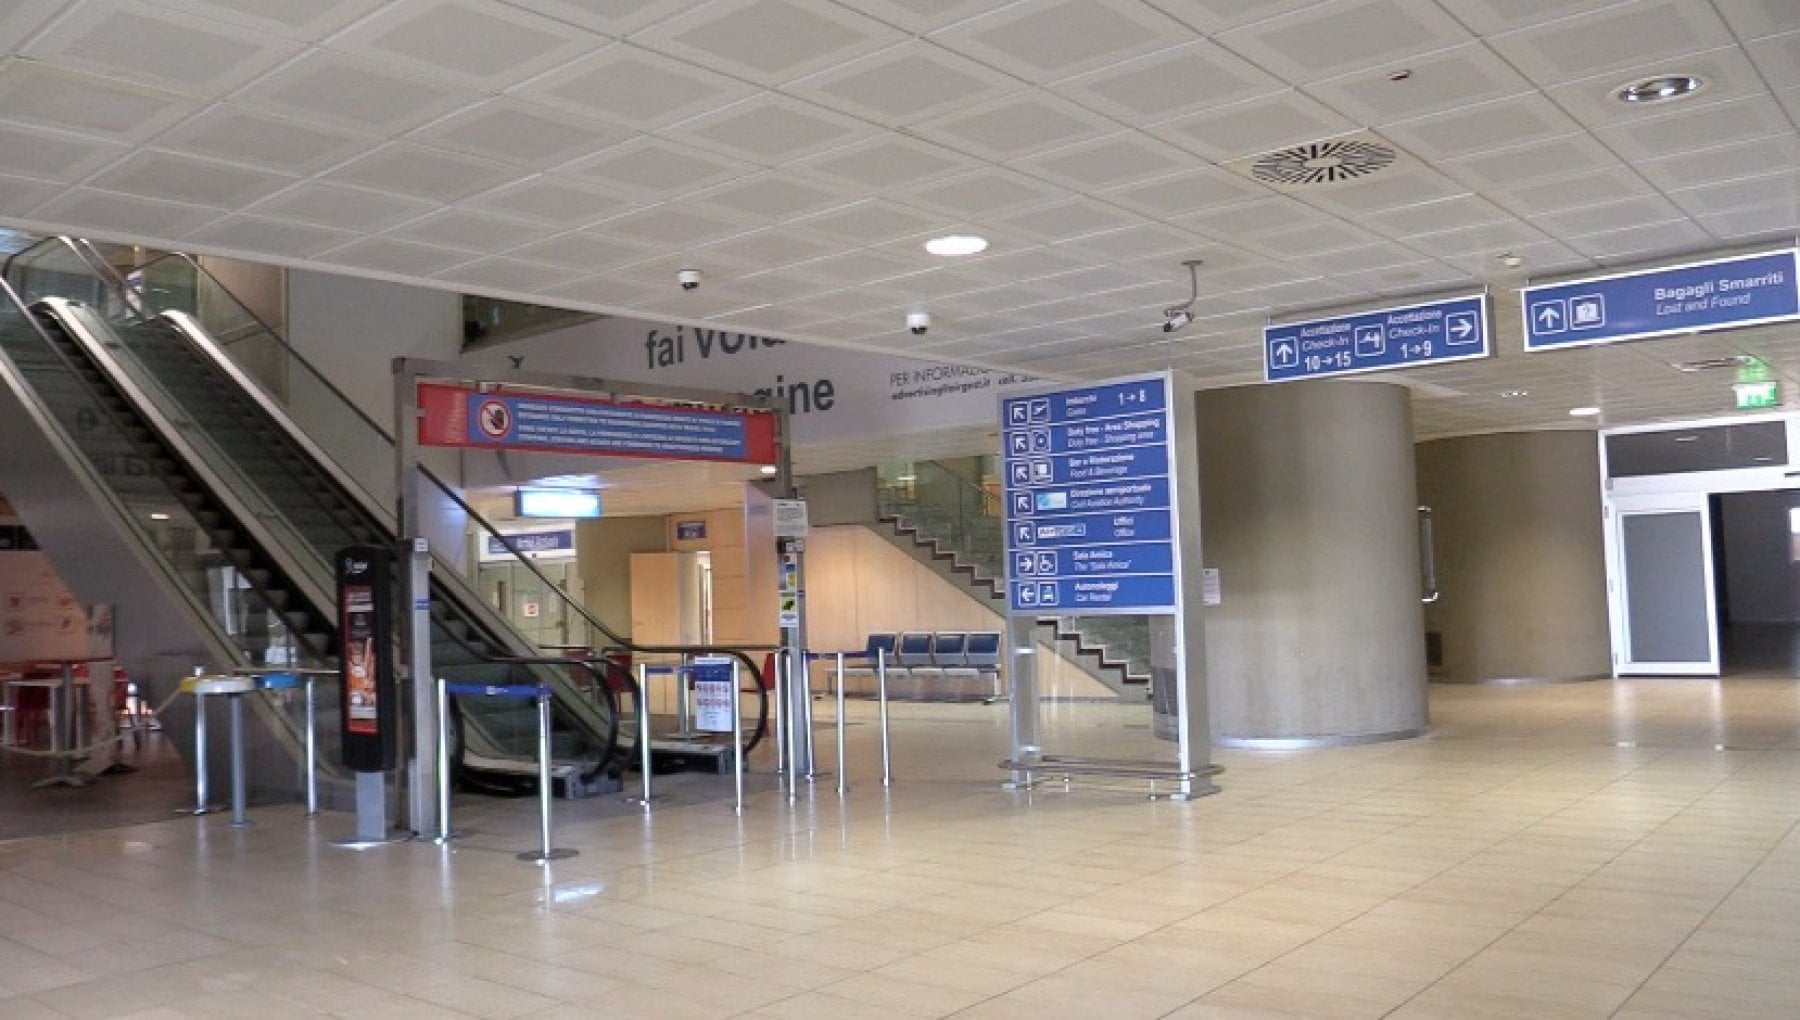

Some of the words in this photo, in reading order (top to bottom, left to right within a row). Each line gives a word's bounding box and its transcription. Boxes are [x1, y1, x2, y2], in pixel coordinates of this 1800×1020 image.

[1653, 280, 1714, 300] Bagagli
[1718, 271, 1784, 292] Smarriti
[1656, 303, 1682, 316] Lost
[1685, 299, 1708, 312] and
[1710, 293, 1751, 309] Found
[1387, 309, 1443, 326] Accettazione
[1300, 323, 1351, 337] Accettazione
[644, 325, 684, 369] fai
[1400, 343, 1408, 359] 1
[1423, 340, 1433, 357] 9
[1304, 355, 1321, 372] 10
[1334, 351, 1351, 368] 15
[889, 371, 910, 387] PER
[1117, 392, 1124, 407] 1
[1124, 418, 1160, 431] Shopping
[1105, 433, 1136, 444] Shopping
